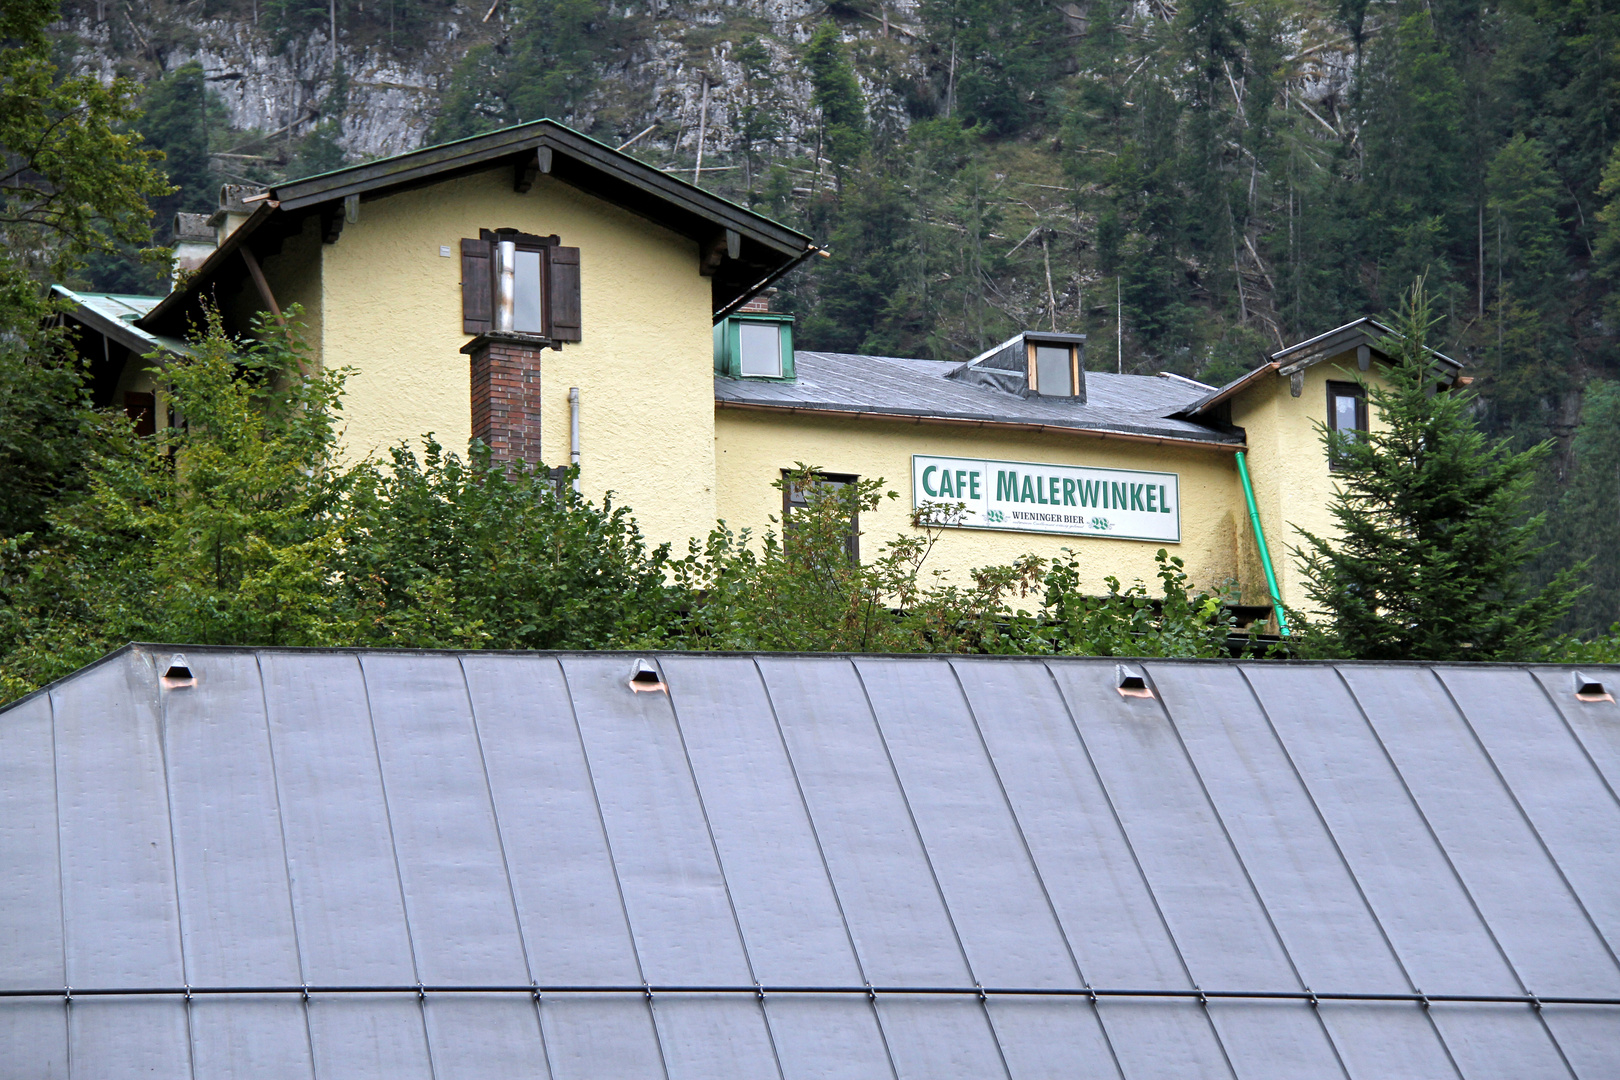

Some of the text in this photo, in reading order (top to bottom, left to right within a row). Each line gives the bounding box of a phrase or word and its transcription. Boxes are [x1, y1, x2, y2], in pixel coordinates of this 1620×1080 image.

[922, 465, 1171, 513] CAFE MALERWINKEL
[1012, 511, 1063, 522] WIENINGER
[1064, 515, 1084, 524] BIER
